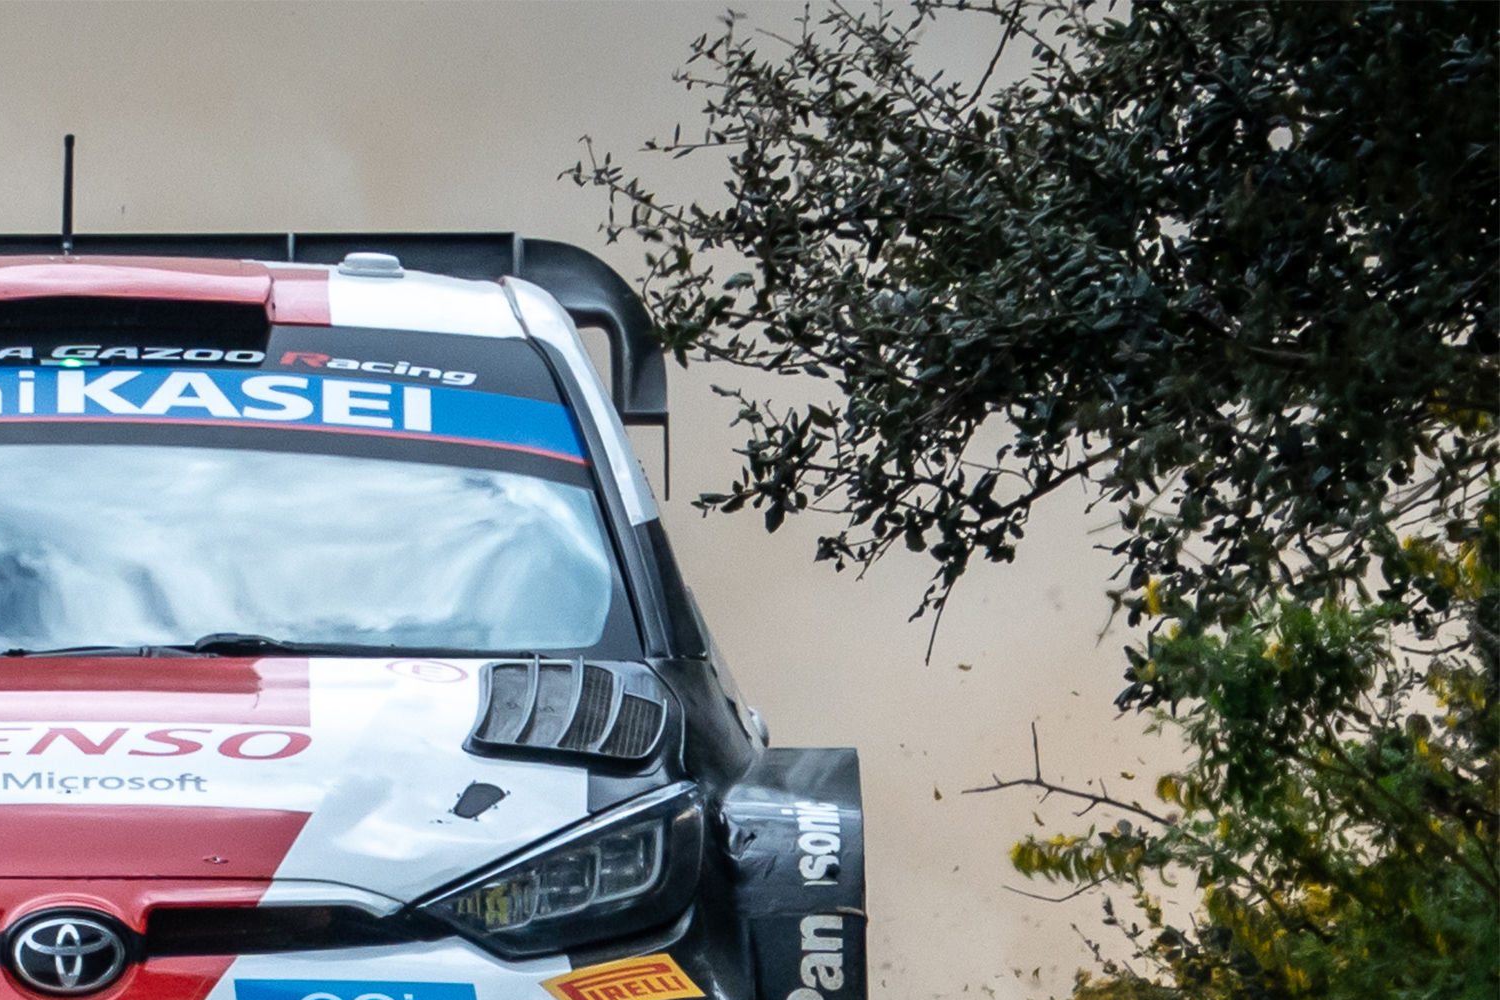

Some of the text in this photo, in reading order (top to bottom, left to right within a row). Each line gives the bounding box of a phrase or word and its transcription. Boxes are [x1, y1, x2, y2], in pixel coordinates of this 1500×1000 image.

[50, 345, 266, 364] GAZOO
[279, 351, 478, 386] Racing
[2, 771, 208, 793] Microsoft
